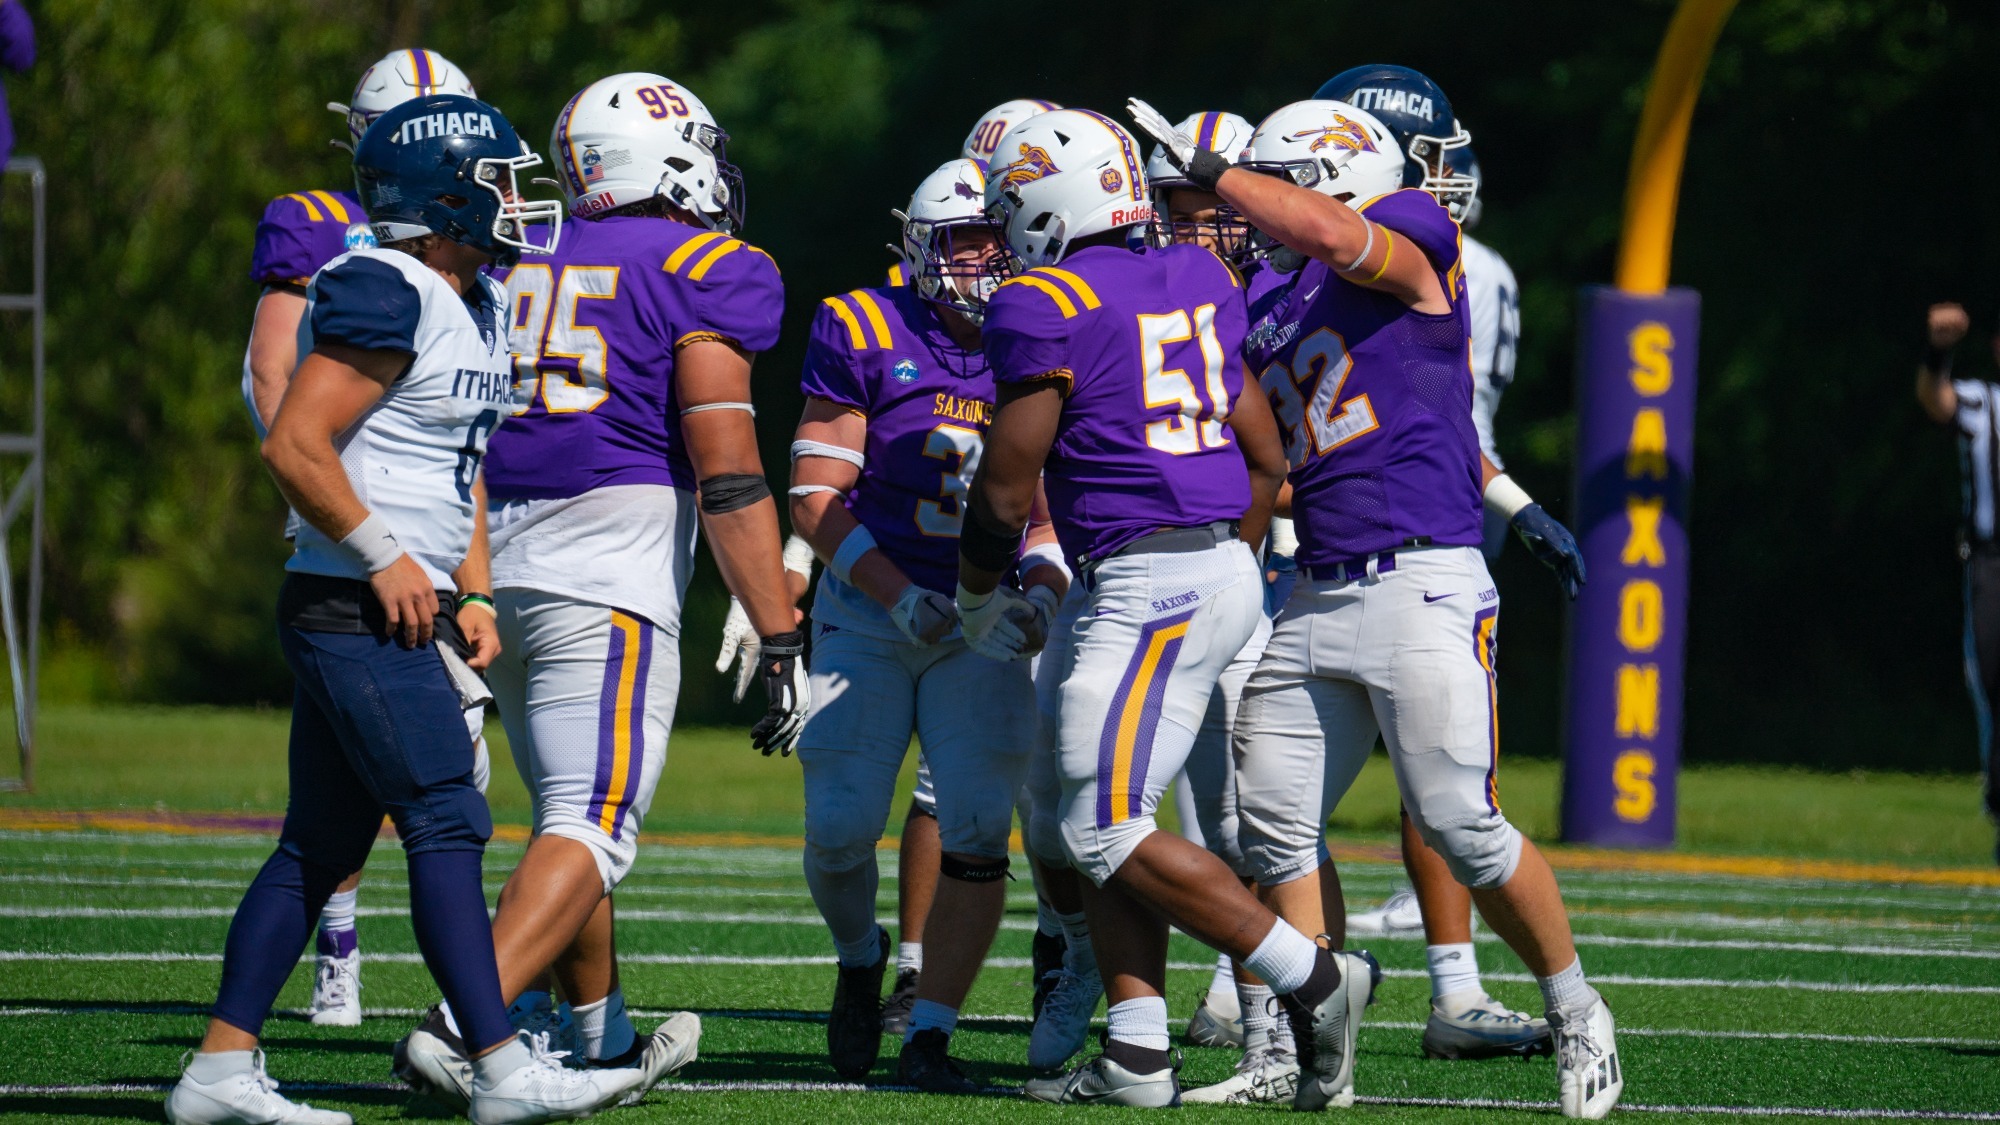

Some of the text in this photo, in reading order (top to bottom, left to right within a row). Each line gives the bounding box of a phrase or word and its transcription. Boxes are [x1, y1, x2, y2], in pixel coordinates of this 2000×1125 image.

[636, 84, 691, 121] 95
[1351, 87, 1434, 123] ITHACA
[401, 112, 497, 146] ITHACA
[971, 120, 1007, 154] 90
[1111, 206, 1150, 227] Ridde
[503, 263, 620, 417] 95
[1137, 303, 1230, 455] 51
[1257, 325, 1381, 467] 32
[933, 392, 994, 426] SAXONS
[1612, 319, 1674, 823] SAXONS
[1151, 590, 1200, 613] SAXONS
